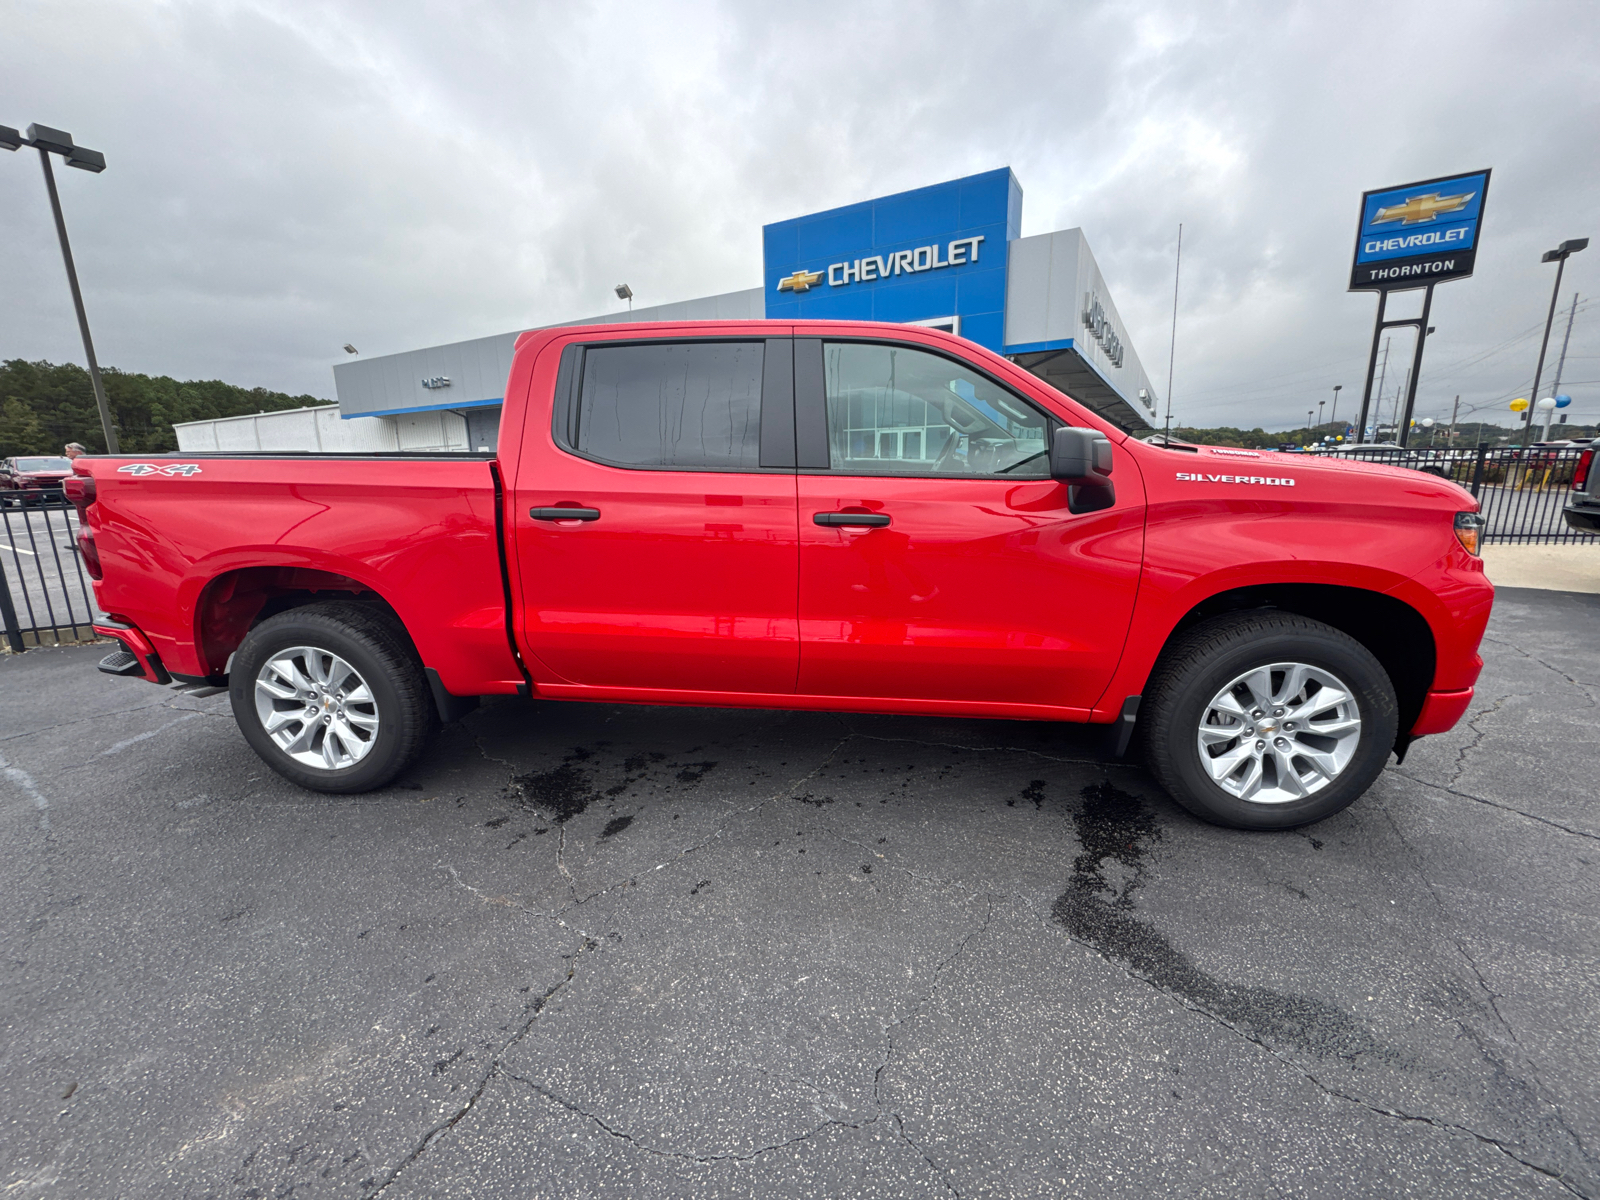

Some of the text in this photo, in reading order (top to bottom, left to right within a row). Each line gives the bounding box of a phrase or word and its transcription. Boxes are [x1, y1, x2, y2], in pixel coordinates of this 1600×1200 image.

[1364, 227, 1469, 253] CHEVROLET
[828, 235, 985, 287] CHEVROLET
[1369, 259, 1455, 280] THORNTON
[1176, 472, 1295, 487] SILVERADO
